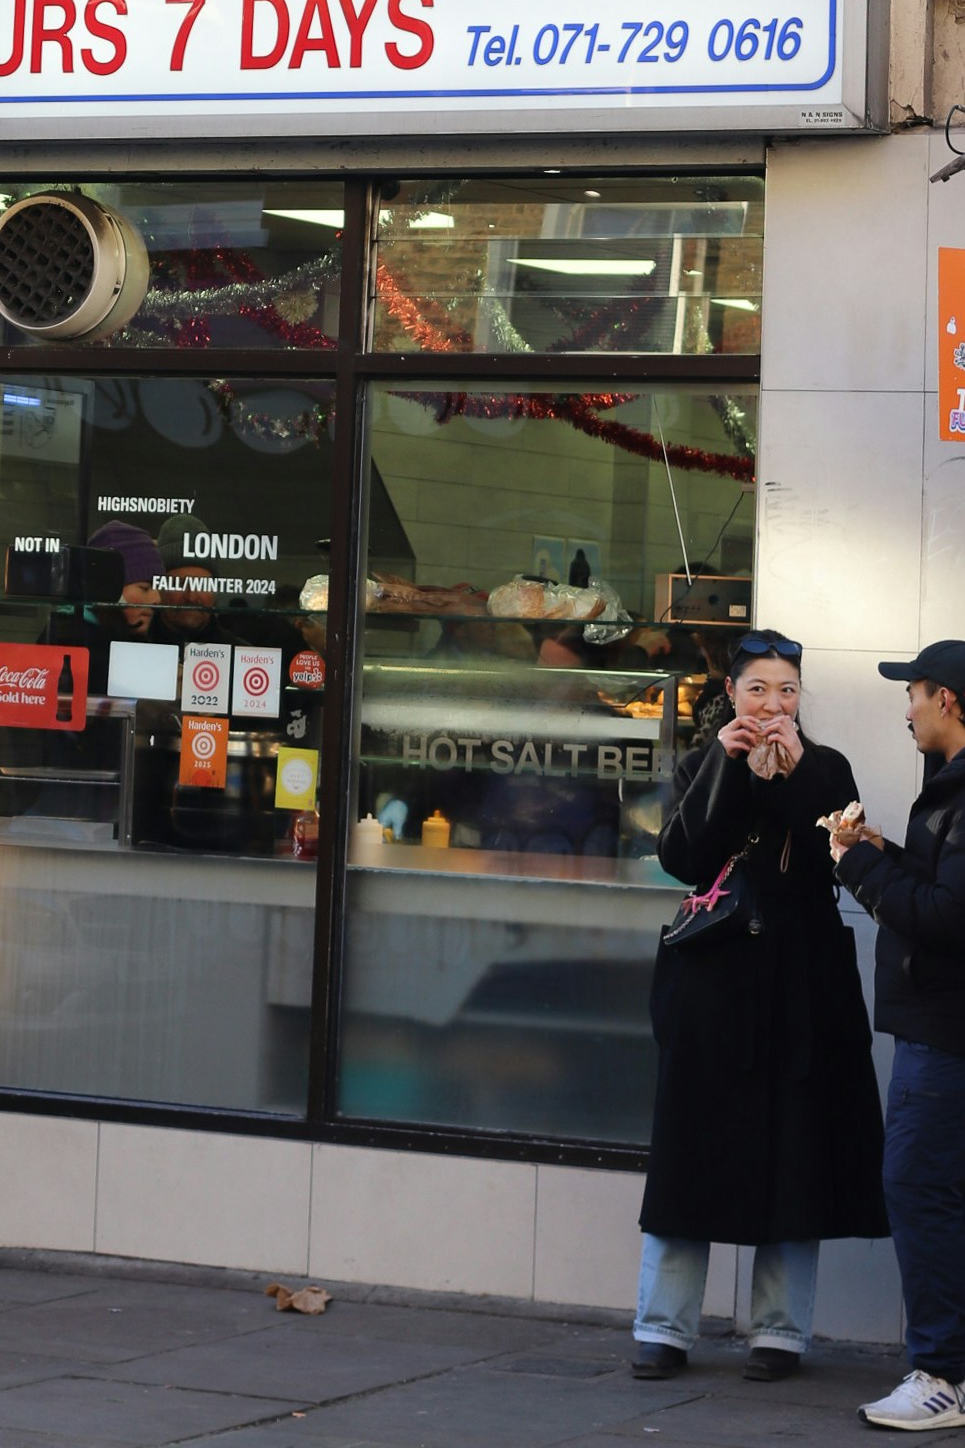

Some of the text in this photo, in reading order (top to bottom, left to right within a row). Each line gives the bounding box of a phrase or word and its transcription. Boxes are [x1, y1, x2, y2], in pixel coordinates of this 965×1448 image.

[708, 16, 804, 62] 0616
[97, 496, 195, 514] HIGHSNOBIETY
[14, 536, 60, 553] NOT IN
[183, 532, 279, 561] LONDON
[152, 574, 276, 595] FALL/WINTER 2024
[189, 647, 225, 659] Harden's
[240, 654, 274, 665] Harden's
[292, 670, 314, 684] yelp
[21, 691, 46, 705] here
[190, 695, 218, 706] 2022
[243, 699, 267, 709] 2024
[188, 719, 223, 732] Harden's
[194, 759, 212, 769] 2025
[402, 734, 675, 783] HOT SALT BEE
